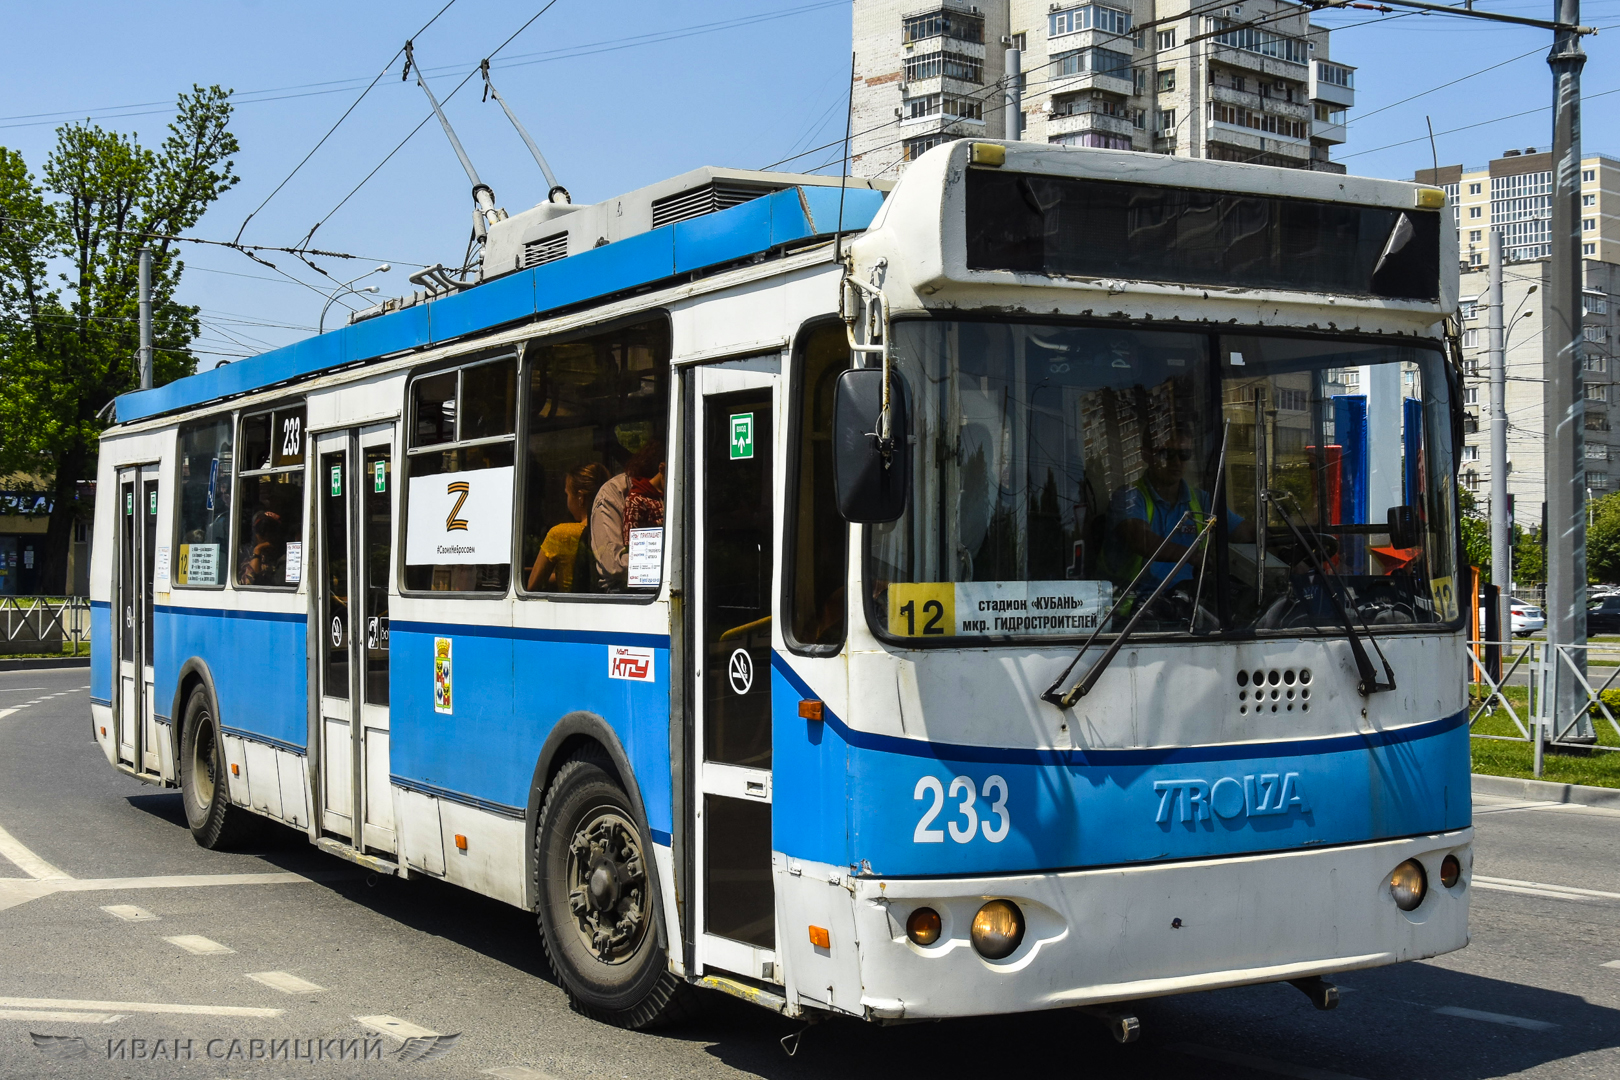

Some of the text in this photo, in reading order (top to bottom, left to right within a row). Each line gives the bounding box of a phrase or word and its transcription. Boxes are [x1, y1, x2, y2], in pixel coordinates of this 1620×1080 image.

[283, 417, 300, 456] 233
[446, 481, 470, 532] Z
[181, 554, 188, 575] 12
[900, 600, 944, 636] 12
[978, 596, 1084, 612] стадион «КУБАНЬ»
[1435, 584, 1456, 618] 12
[962, 613, 1098, 633] мкр. ГИДРОСТРОИТЕЛЕЙ
[913, 775, 1010, 844] 233
